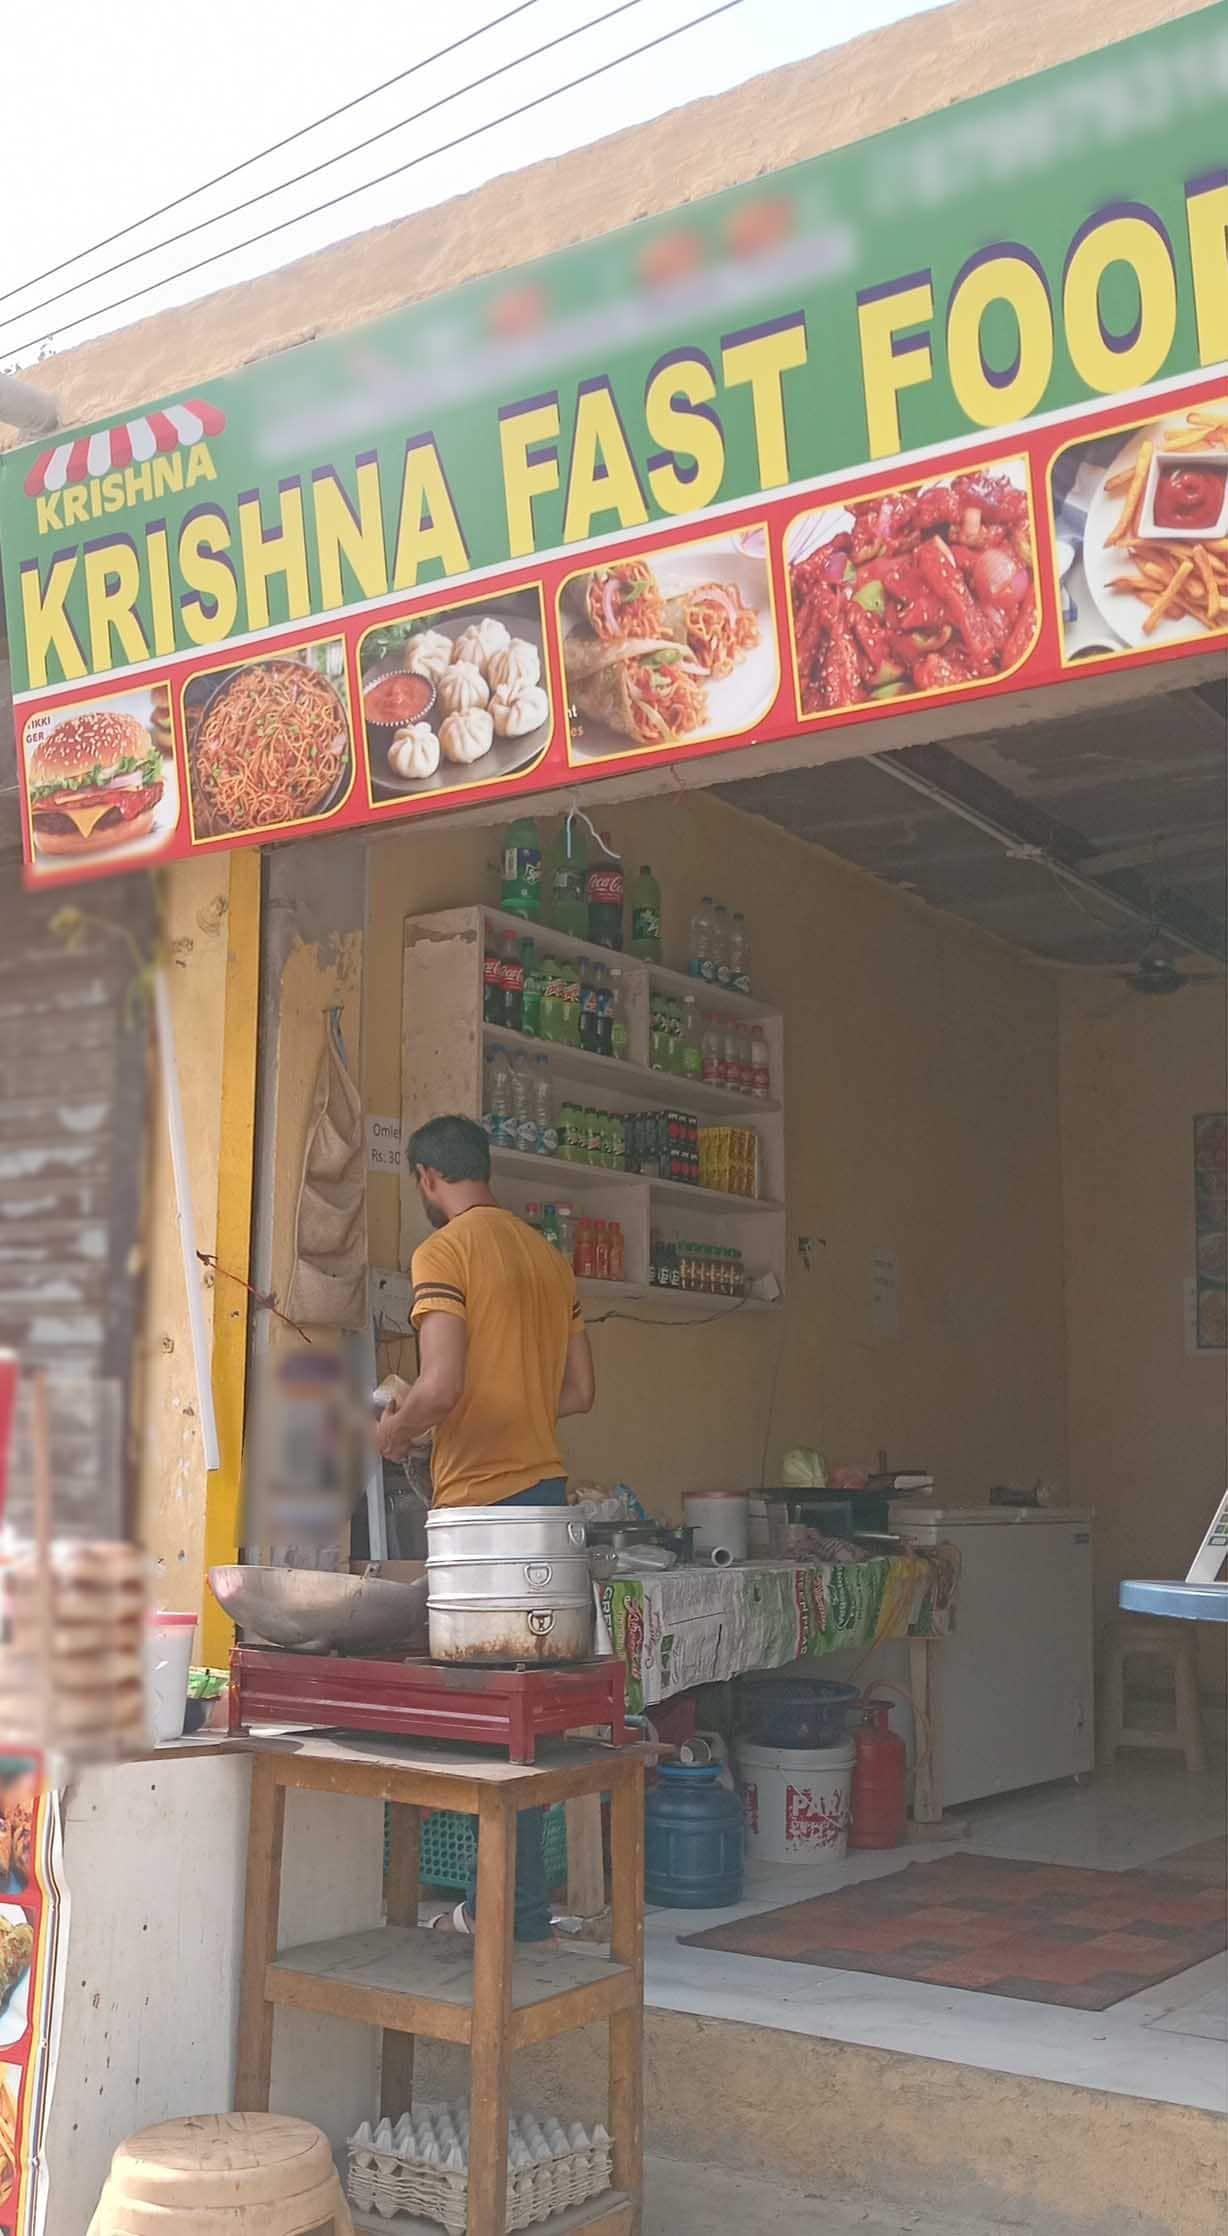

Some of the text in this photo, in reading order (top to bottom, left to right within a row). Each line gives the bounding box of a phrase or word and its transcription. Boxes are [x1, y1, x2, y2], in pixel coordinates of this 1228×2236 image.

[20, 431, 471, 690] KRISHNA
[497, 310, 808, 559] FAST
[36, 441, 217, 535] KRISHNA
